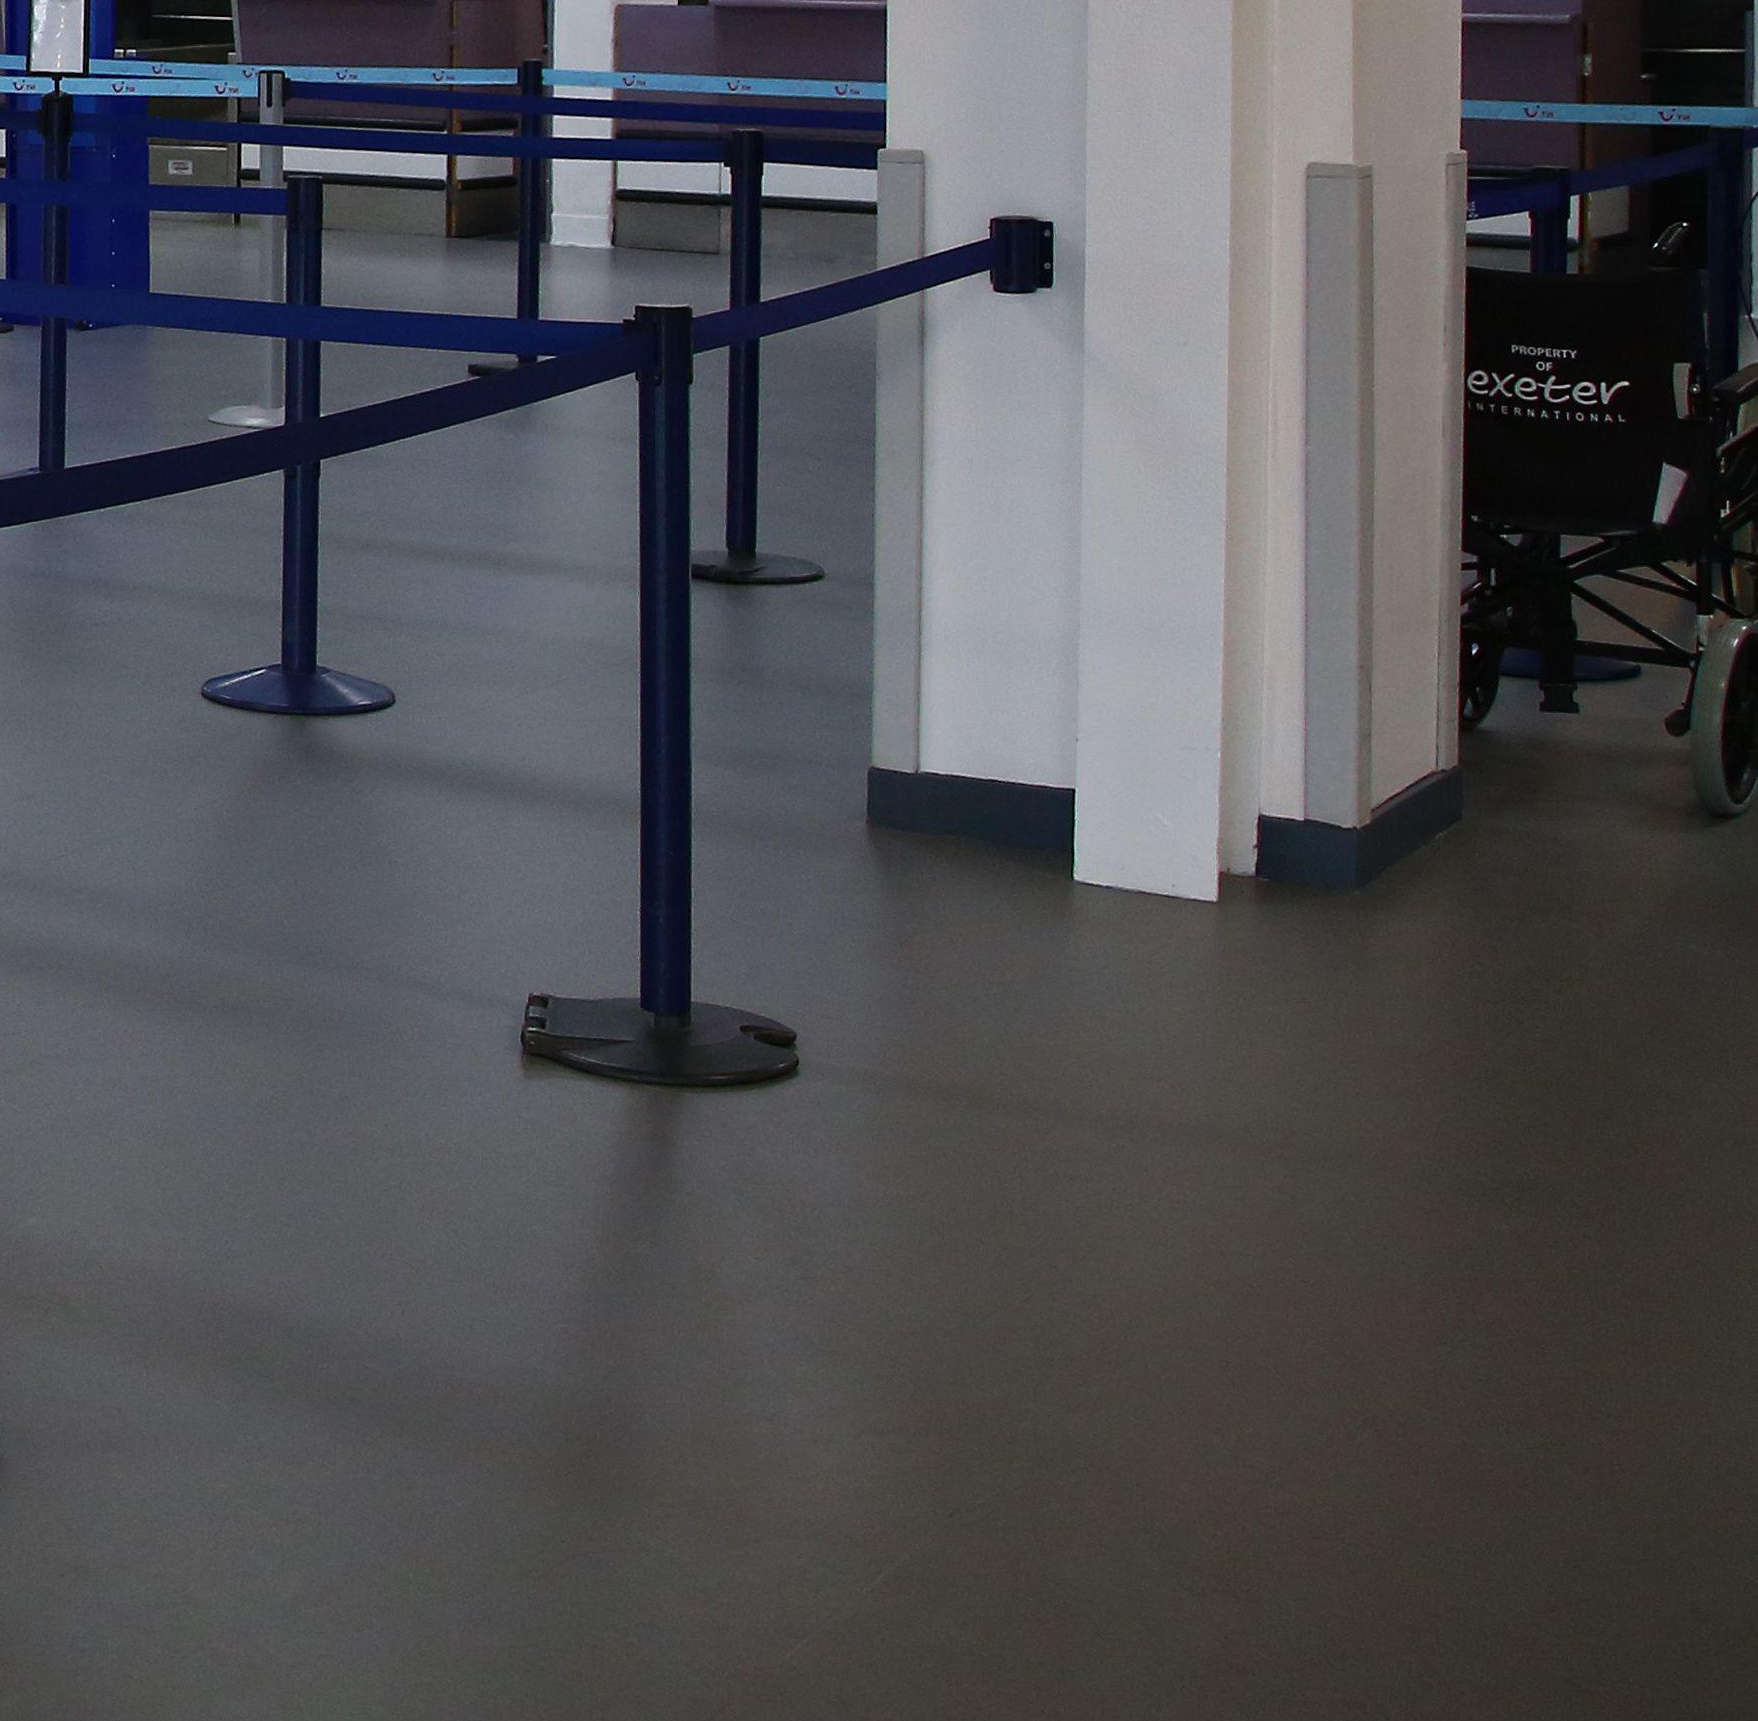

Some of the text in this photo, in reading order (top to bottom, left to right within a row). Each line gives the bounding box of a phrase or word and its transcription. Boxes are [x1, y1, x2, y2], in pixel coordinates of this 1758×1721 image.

[1510, 344, 1578, 359] PROPERTY
[1535, 360, 1554, 372] OF
[1467, 370, 1631, 405] exeter
[1468, 403, 1626, 422] INTERNATIONAL
